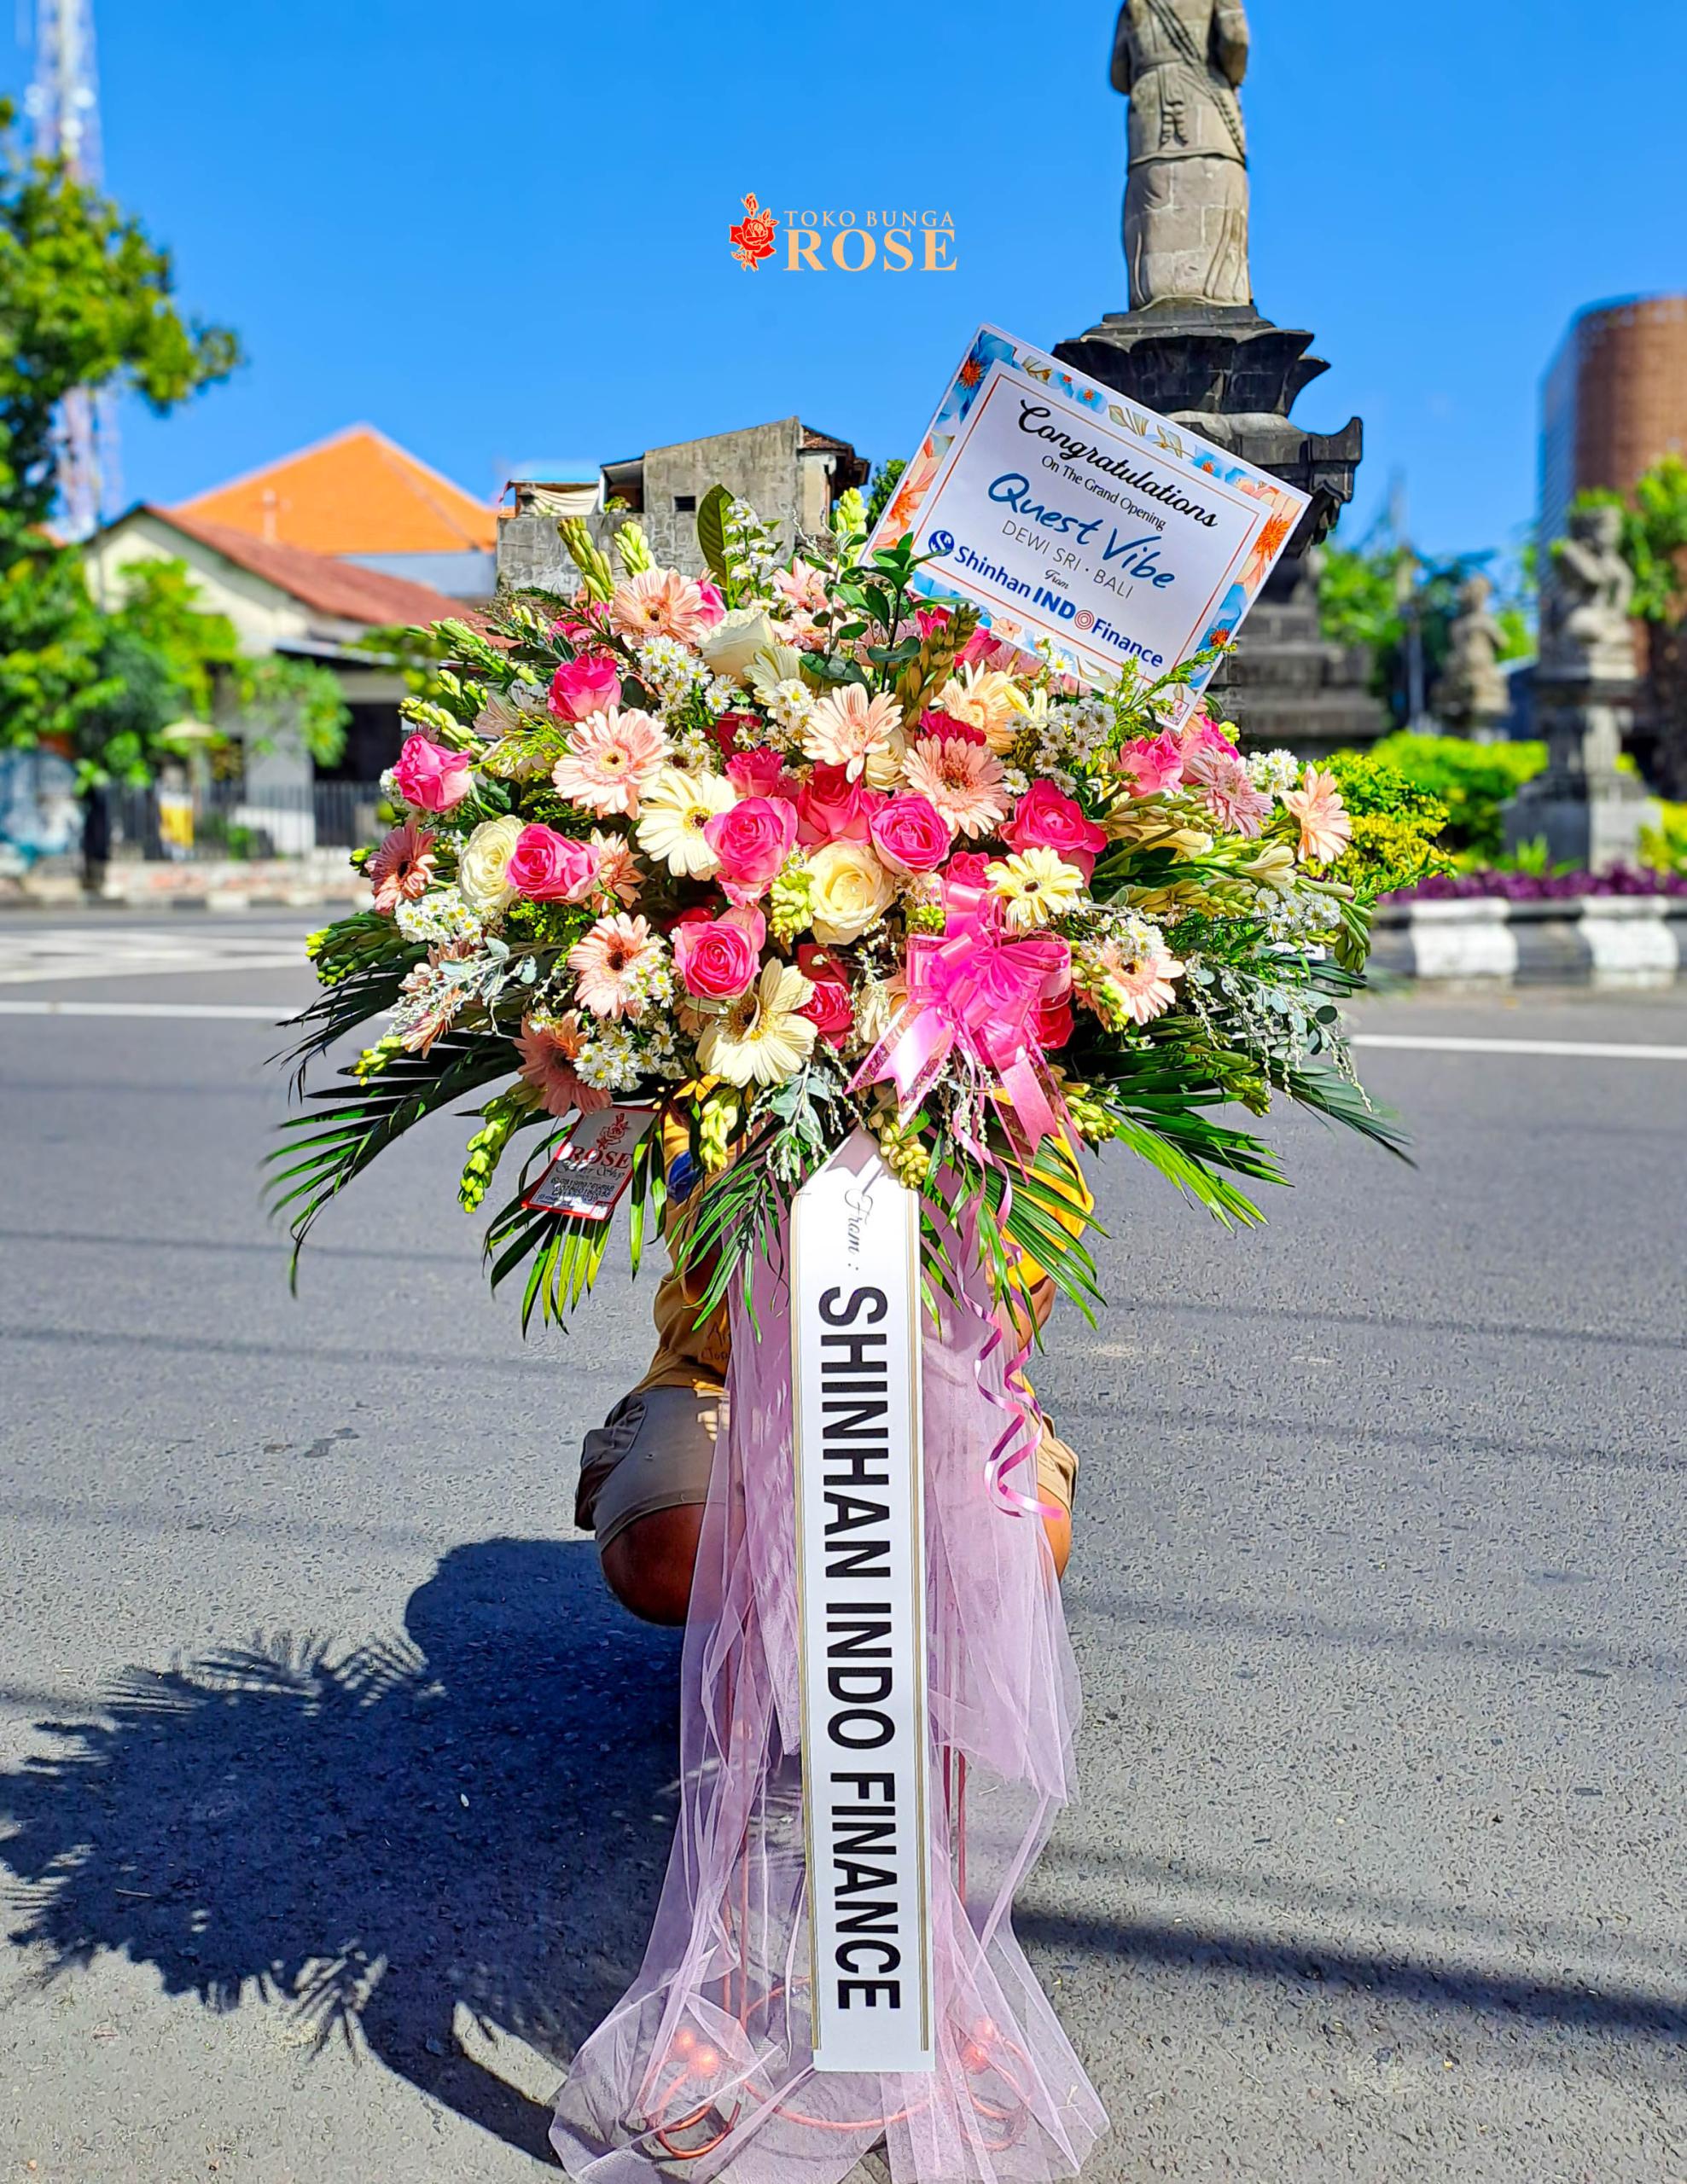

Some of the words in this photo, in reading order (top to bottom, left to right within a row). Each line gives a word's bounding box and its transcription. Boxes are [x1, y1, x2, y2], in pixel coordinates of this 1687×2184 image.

[1018, 399, 1219, 527] Congratulations
[1042, 456, 1060, 473] On
[1062, 465, 1083, 485] The
[1085, 478, 1120, 504] Grand
[1120, 497, 1166, 531] Opening
[988, 473, 1103, 545] Quest
[1102, 528, 1175, 588] Vibe
[1002, 520, 1050, 555] DEWI
[1053, 548, 1081, 572] SRI
[1093, 569, 1134, 599] BALI
[1044, 569, 1069, 590] From
[954, 546, 1032, 598] Shinhan
[1091, 618, 1163, 667] Finance
[569, 1146, 632, 1169] ROSE
[818, 1286, 891, 1577] SHINHAN
[826, 1602, 895, 1750] INDO
[830, 1772, 901, 2010] FINANCE
